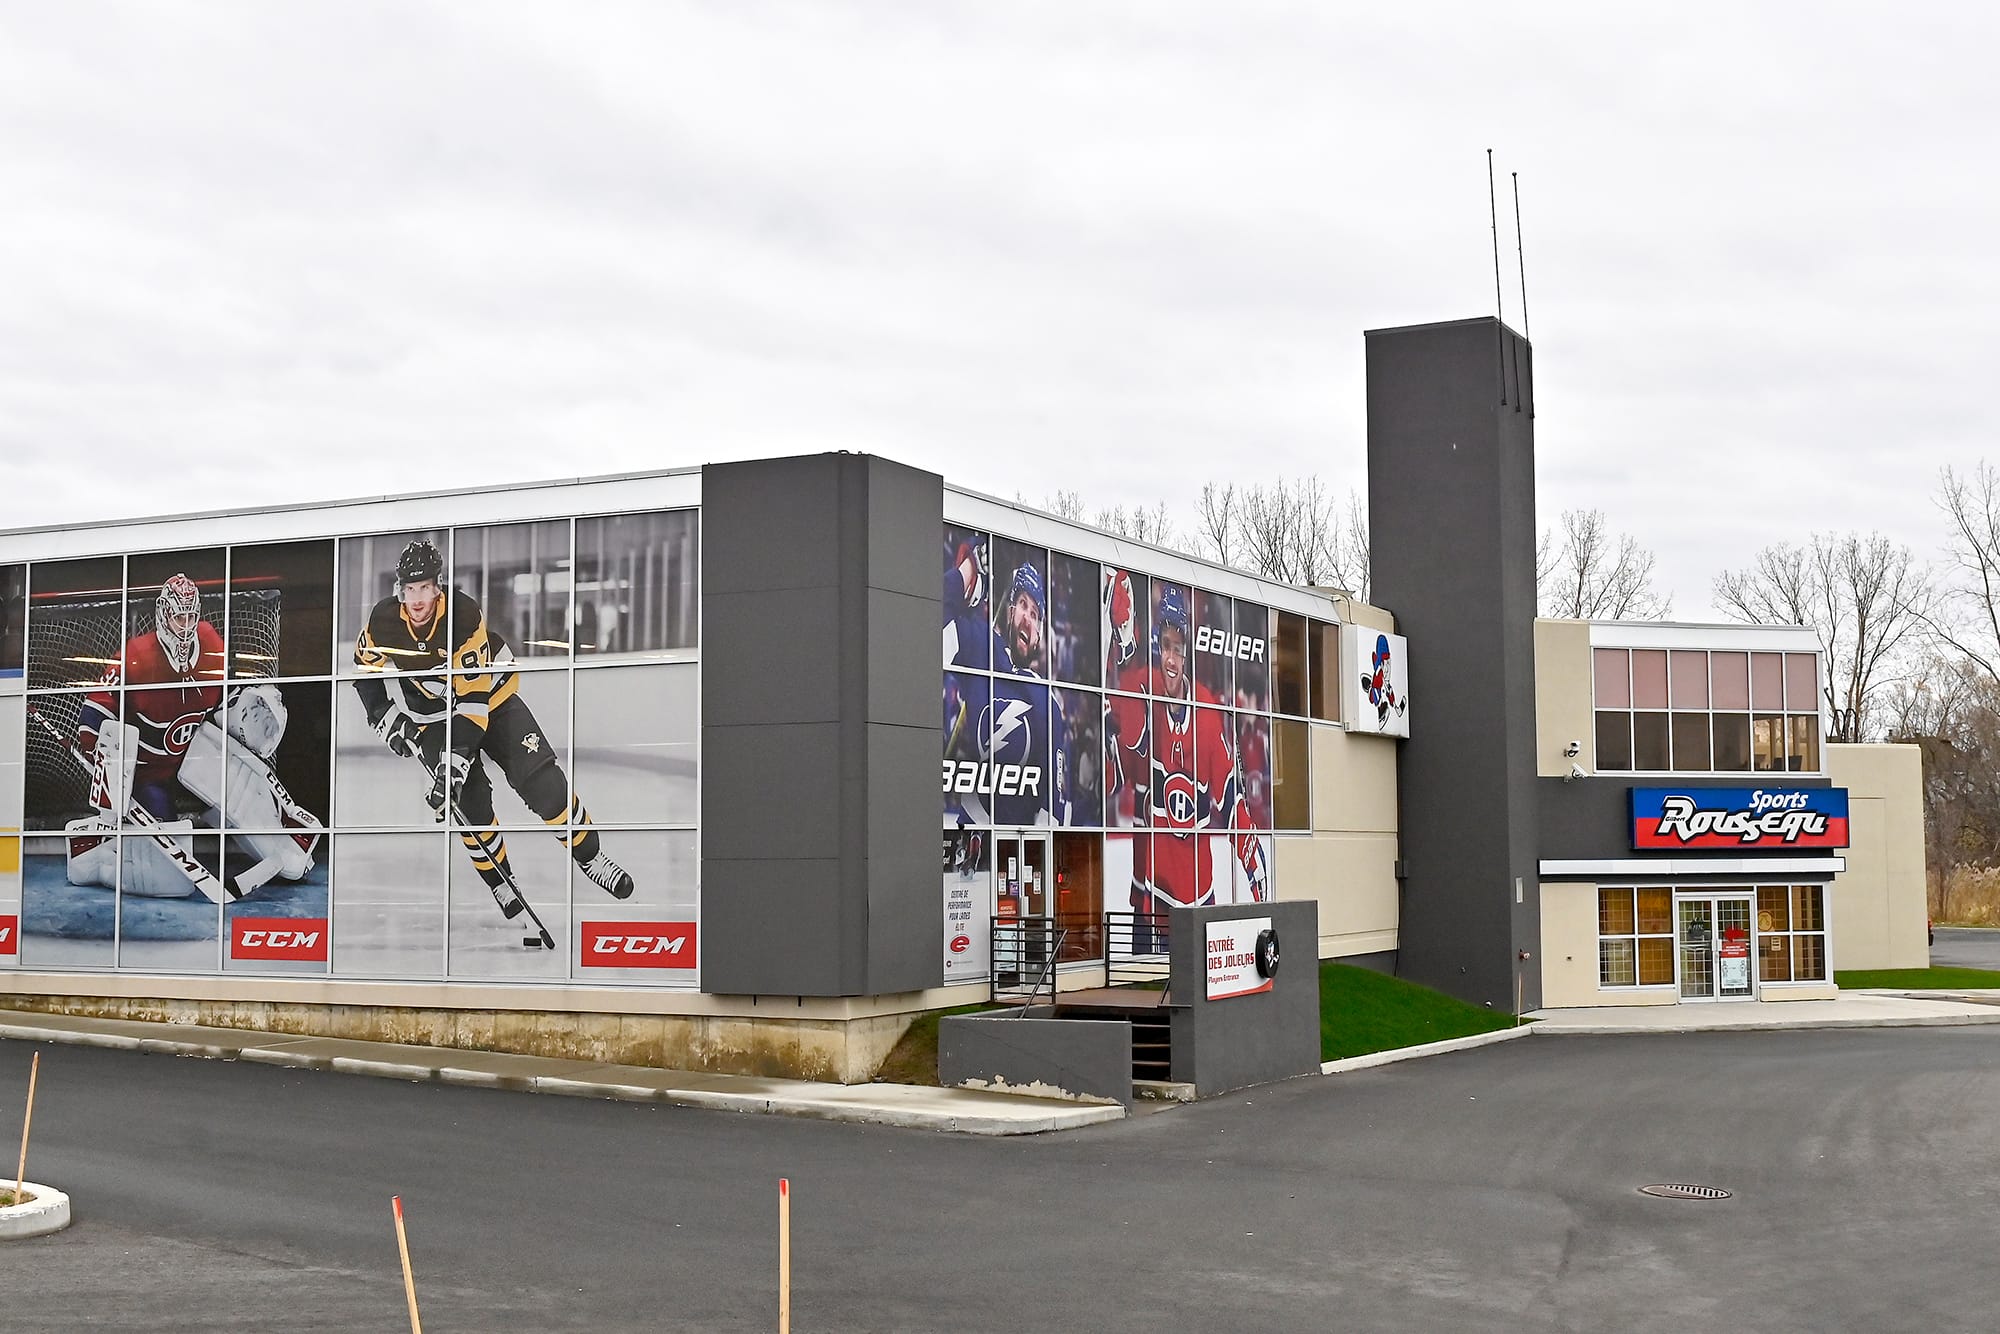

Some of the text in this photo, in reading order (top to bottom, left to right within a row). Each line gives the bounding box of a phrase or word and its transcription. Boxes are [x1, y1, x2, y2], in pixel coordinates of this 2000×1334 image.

[266, 772, 292, 806] CCM
[1749, 790, 1808, 814] Sports
[241, 930, 320, 948] CCM
[593, 936, 686, 954] CCM
[1208, 936, 1234, 953] ENTRÉE
[1208, 953, 1254, 970] DES JOUEURS
